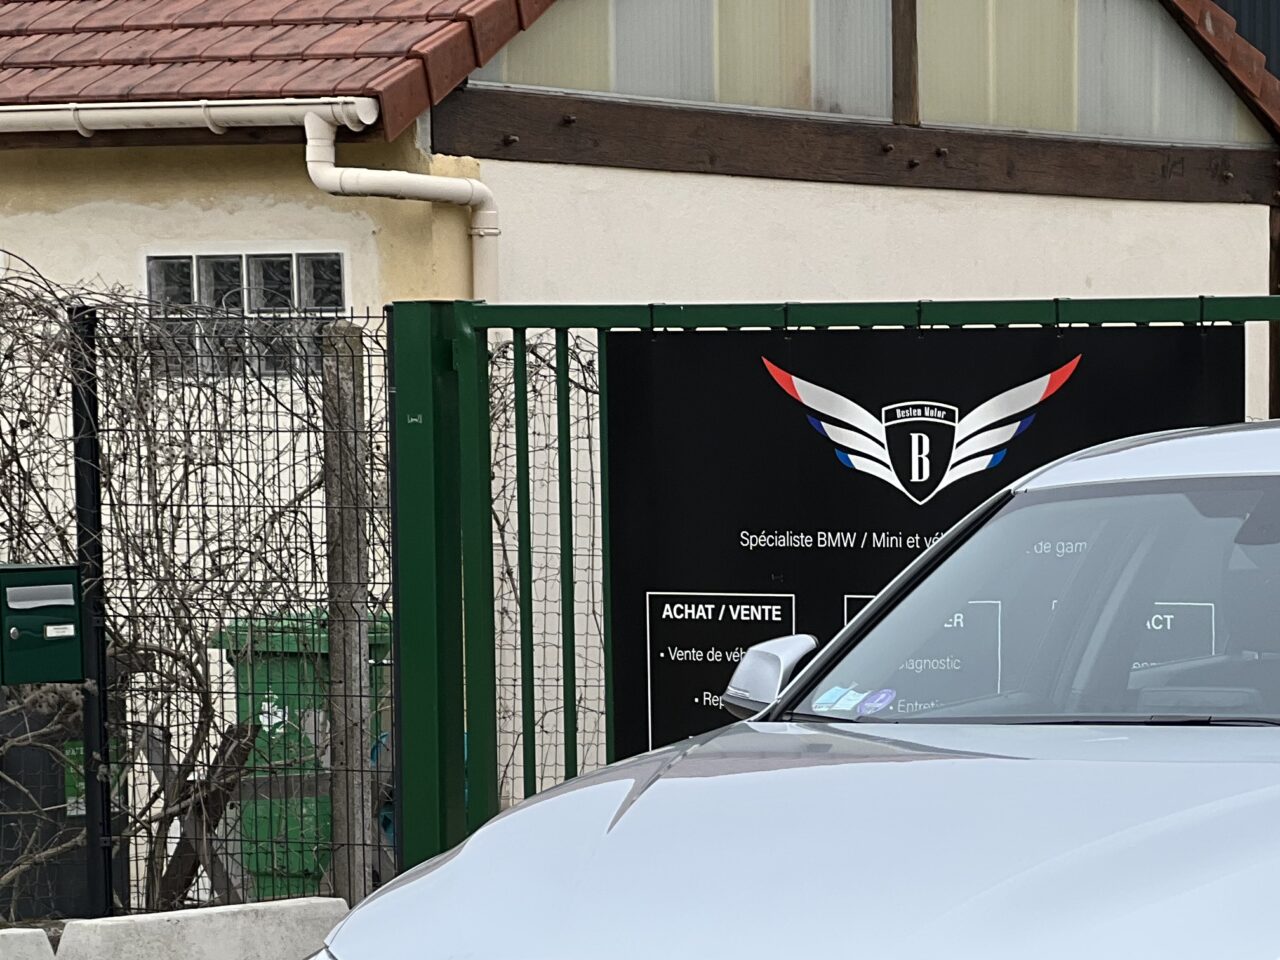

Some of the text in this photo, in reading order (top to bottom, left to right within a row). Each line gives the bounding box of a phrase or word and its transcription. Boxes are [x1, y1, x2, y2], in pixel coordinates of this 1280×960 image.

[909, 432, 930, 482] B
[739, 530, 813, 550] Spécialiste
[817, 531, 856, 548] BMW
[860, 532, 867, 549] /
[872, 532, 902, 548] Mini
[906, 533, 920, 549] et
[1033, 541, 1051, 554] de
[662, 603, 782, 621] ACHAT / VENTE
[667, 646, 704, 661] Vente
[706, 647, 722, 662] de
